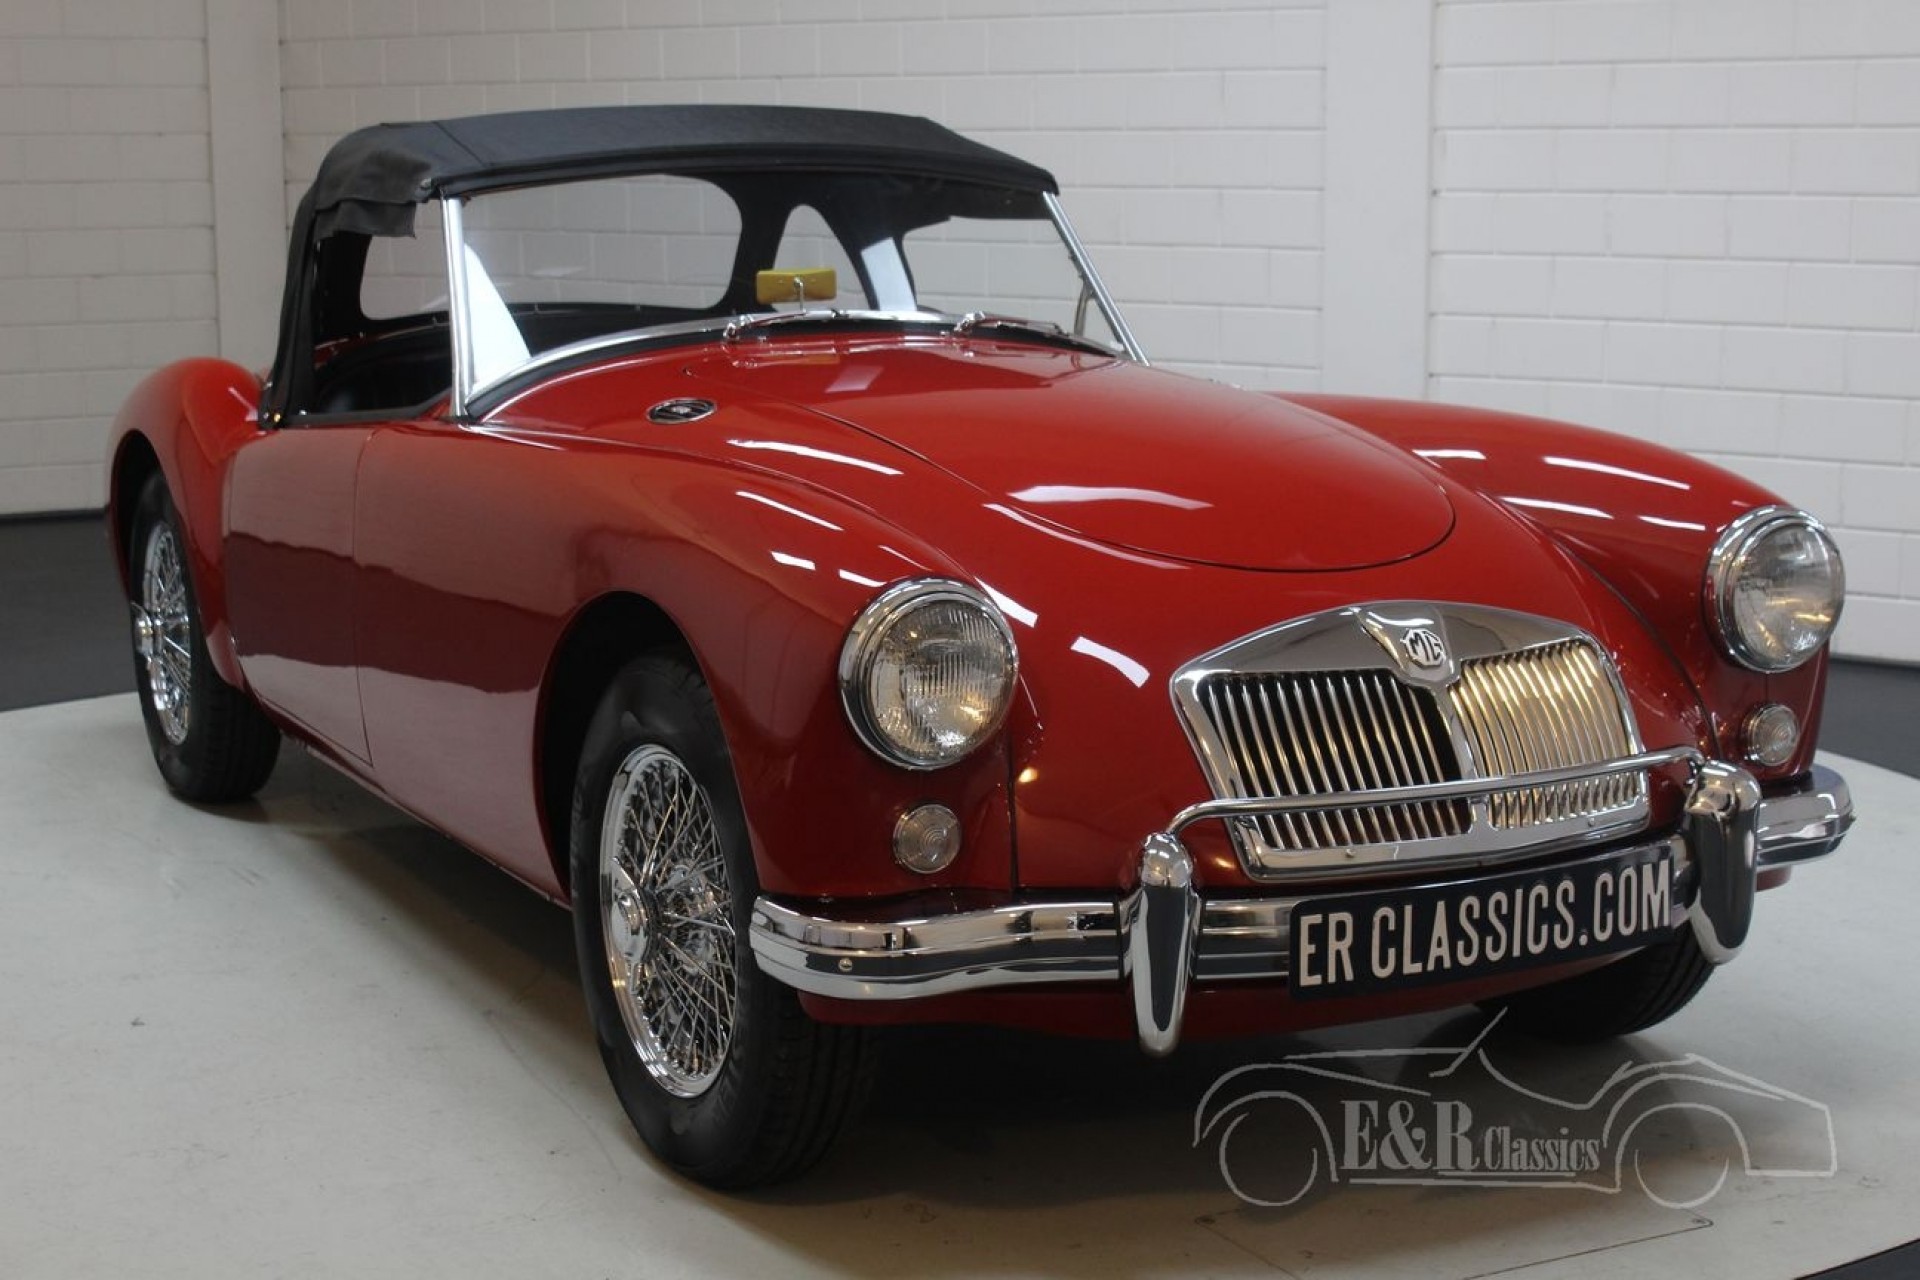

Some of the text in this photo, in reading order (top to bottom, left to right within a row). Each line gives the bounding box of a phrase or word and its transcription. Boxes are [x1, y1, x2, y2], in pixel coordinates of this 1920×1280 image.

[1406, 629, 1445, 665] MG
[1299, 859, 1670, 987] ER CLASSICS.COM
